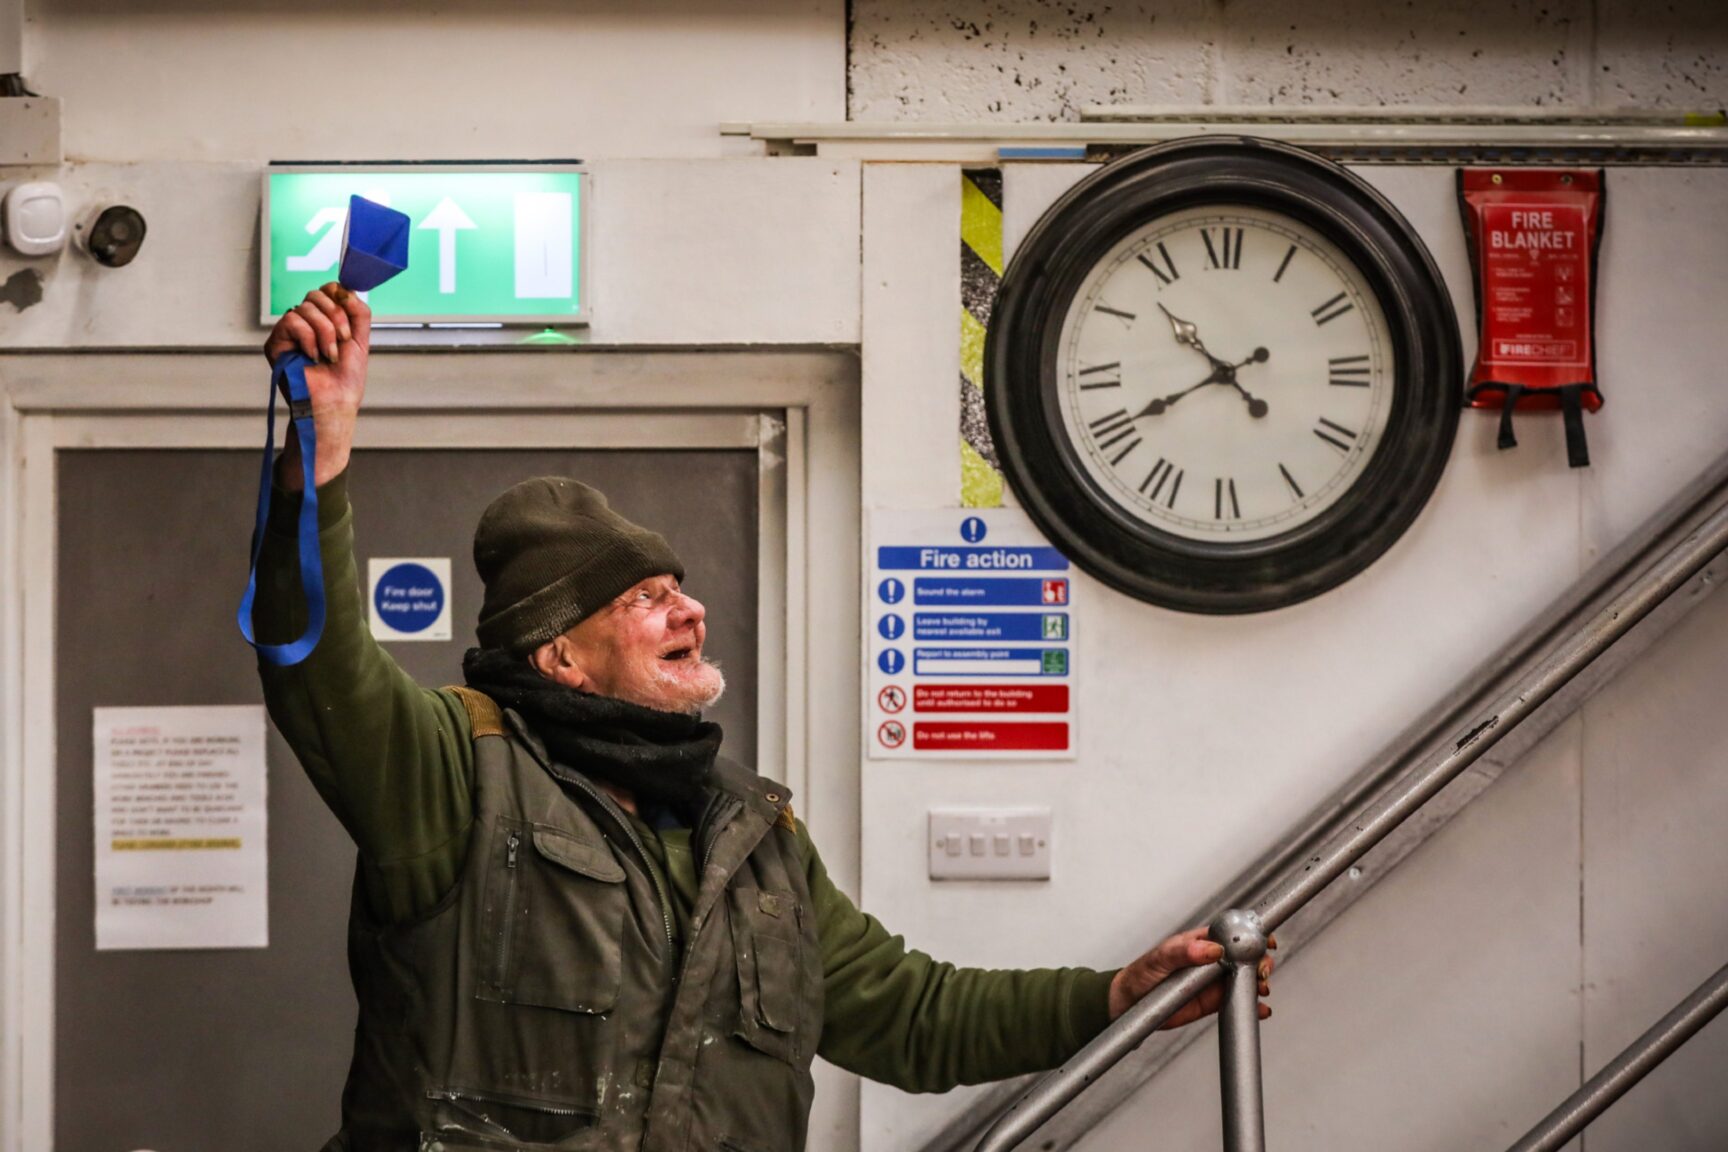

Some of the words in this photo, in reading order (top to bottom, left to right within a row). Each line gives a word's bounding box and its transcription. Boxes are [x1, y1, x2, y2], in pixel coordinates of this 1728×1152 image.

[1511, 211, 1553, 229] FIRE
[1491, 230, 1575, 249] BLANKET
[920, 549, 960, 568] Fire
[966, 550, 1032, 568] action
[917, 587, 945, 596] Sound
[946, 587, 959, 596] the
[942, 617, 976, 628] building
[916, 689, 929, 698] Do
[930, 690, 945, 698] not
[984, 690, 998, 698] the
[916, 731, 929, 740] Do
[930, 731, 946, 740] not
[963, 731, 977, 740] the
